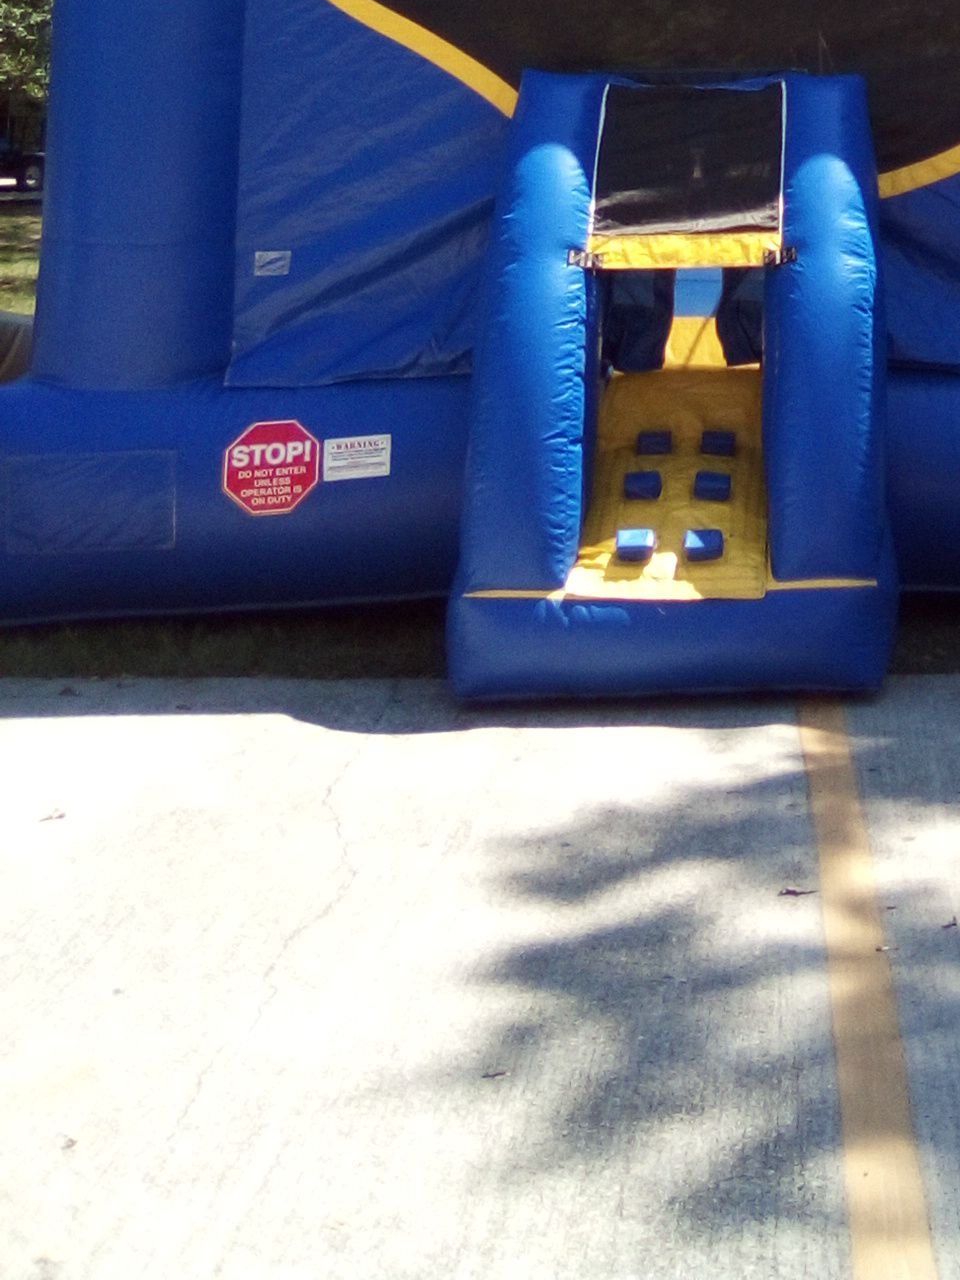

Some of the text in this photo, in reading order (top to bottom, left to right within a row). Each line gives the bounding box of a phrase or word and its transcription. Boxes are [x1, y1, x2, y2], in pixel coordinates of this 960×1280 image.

[335, 440, 379, 450] WARNING
[232, 441, 311, 467] STOP!
[238, 466, 306, 479] DO NOT ENTER
[254, 477, 291, 487] UNLESS
[240, 485, 302, 497] OPERATOR IS
[251, 495, 292, 505] ON DUTY
